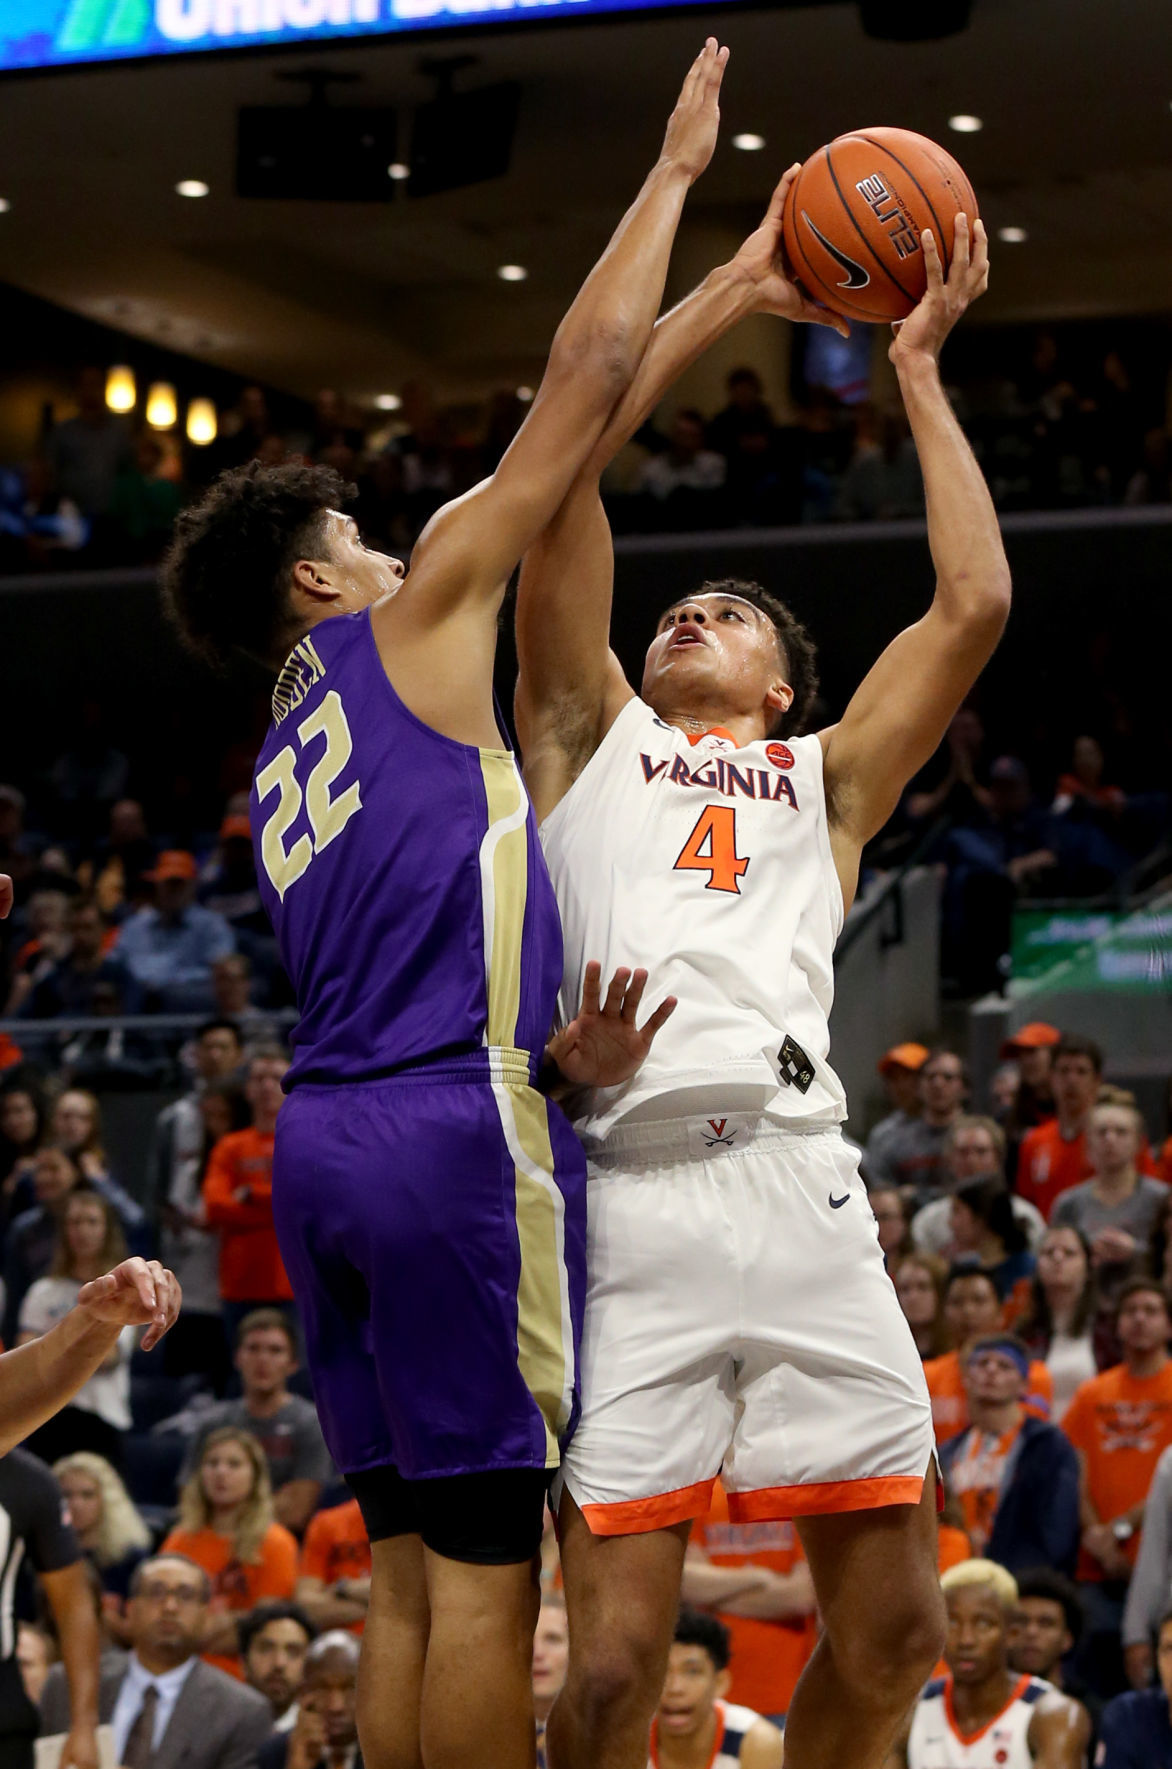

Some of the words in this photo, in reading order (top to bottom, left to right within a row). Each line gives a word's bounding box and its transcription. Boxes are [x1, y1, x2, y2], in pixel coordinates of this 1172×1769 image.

[856, 174, 920, 260] ELITE
[255, 689, 364, 904] 22
[639, 751, 800, 813] VRGINIA
[672, 804, 751, 895] 4
